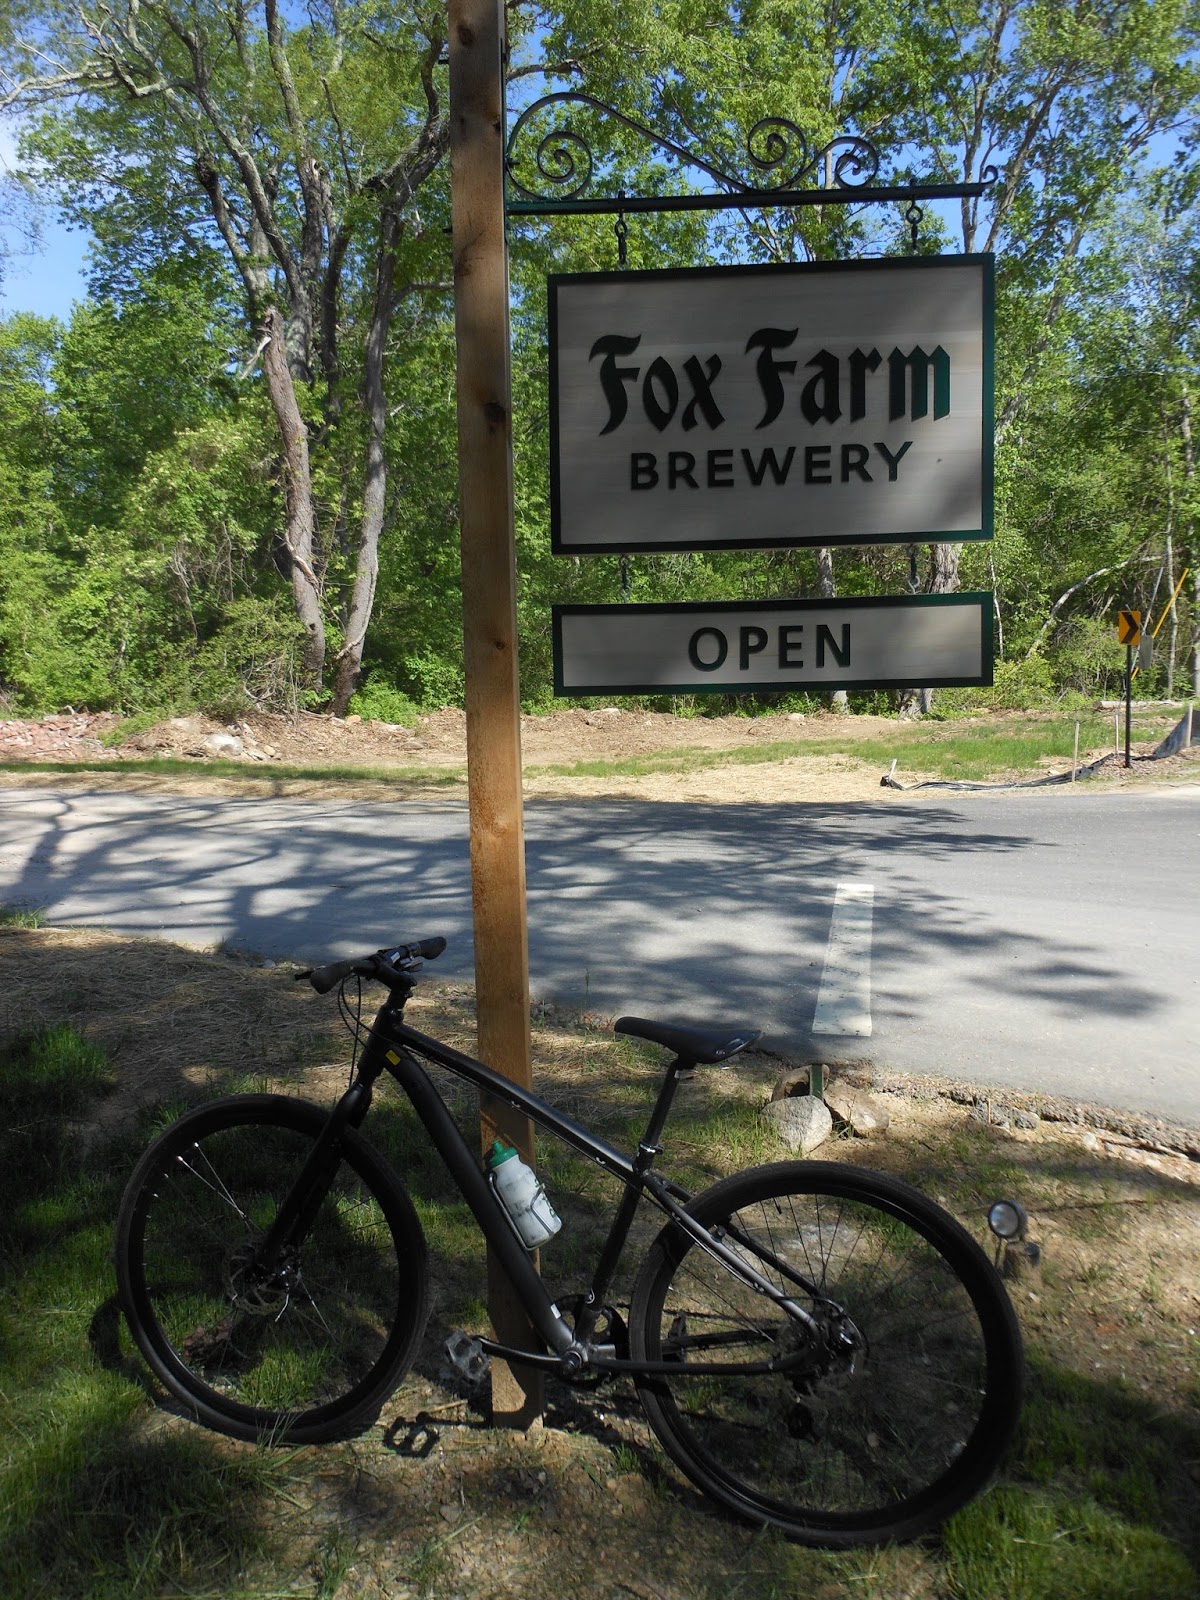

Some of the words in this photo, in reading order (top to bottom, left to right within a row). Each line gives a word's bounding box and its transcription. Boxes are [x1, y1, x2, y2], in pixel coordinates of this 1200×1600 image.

[589, 334, 725, 436] Fox
[745, 327, 951, 430] Farm
[630, 441, 913, 490] BREWERY
[688, 623, 851, 671] OPEN
